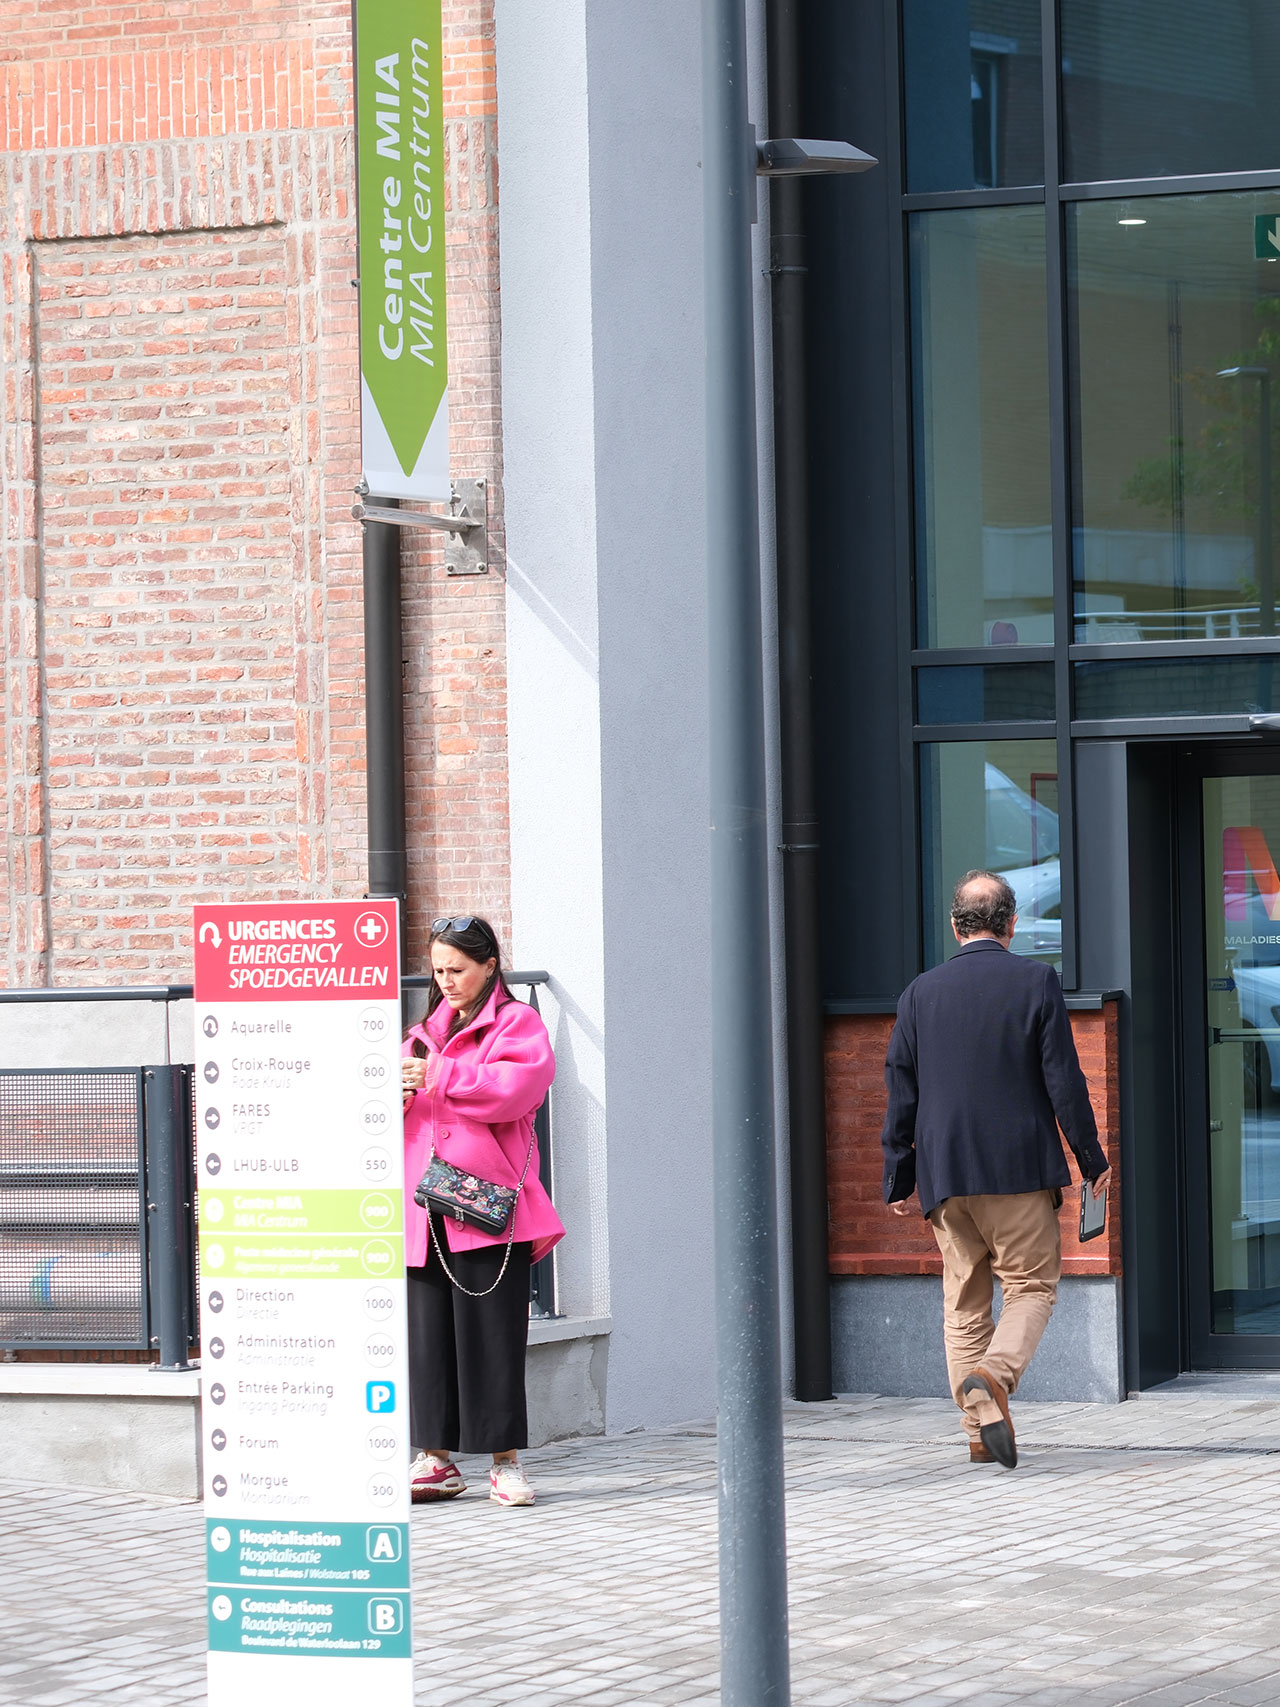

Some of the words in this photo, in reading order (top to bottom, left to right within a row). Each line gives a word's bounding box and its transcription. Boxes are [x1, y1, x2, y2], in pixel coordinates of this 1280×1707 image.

[375, 52, 401, 161] MIA
[408, 38, 433, 253] Centrum
[379, 175, 404, 361] Centre
[409, 272, 434, 367] MIA
[228, 919, 336, 940] URGENCES
[229, 943, 343, 964] EMERGENCY
[229, 966, 388, 988] SPOEDGEVALLEN
[231, 1020, 292, 1035] Aquarelle
[363, 1020, 384, 1031] 700
[231, 1058, 311, 1073] Croix-Rouge
[363, 1066, 385, 1077] 800
[232, 1104, 270, 1117] FARES
[364, 1113, 386, 1124] 800
[233, 1159, 299, 1172] LHUB-ULB
[365, 1160, 387, 1171] 550
[365, 1205, 388, 1217] 900
[236, 1289, 295, 1303] Direction
[366, 1299, 393, 1309] 1000
[237, 1335, 335, 1349] Administration
[367, 1345, 394, 1356] 1000
[238, 1380, 278, 1394] Entrée
[282, 1380, 334, 1398] Parking
[371, 1385, 391, 1412] P
[239, 1436, 279, 1449] Forum
[368, 1438, 396, 1449] 1000
[240, 1473, 289, 1489] Morgue
[372, 1485, 394, 1496] 300
[239, 1529, 341, 1547] Hospitalisation
[373, 1533, 394, 1557] A
[240, 1548, 321, 1564] Hospitalisatie
[240, 1598, 333, 1615] Consultations
[376, 1605, 395, 1630] B
[241, 1616, 332, 1636] Raadplegingen
[362, 1640, 381, 1649] 129
